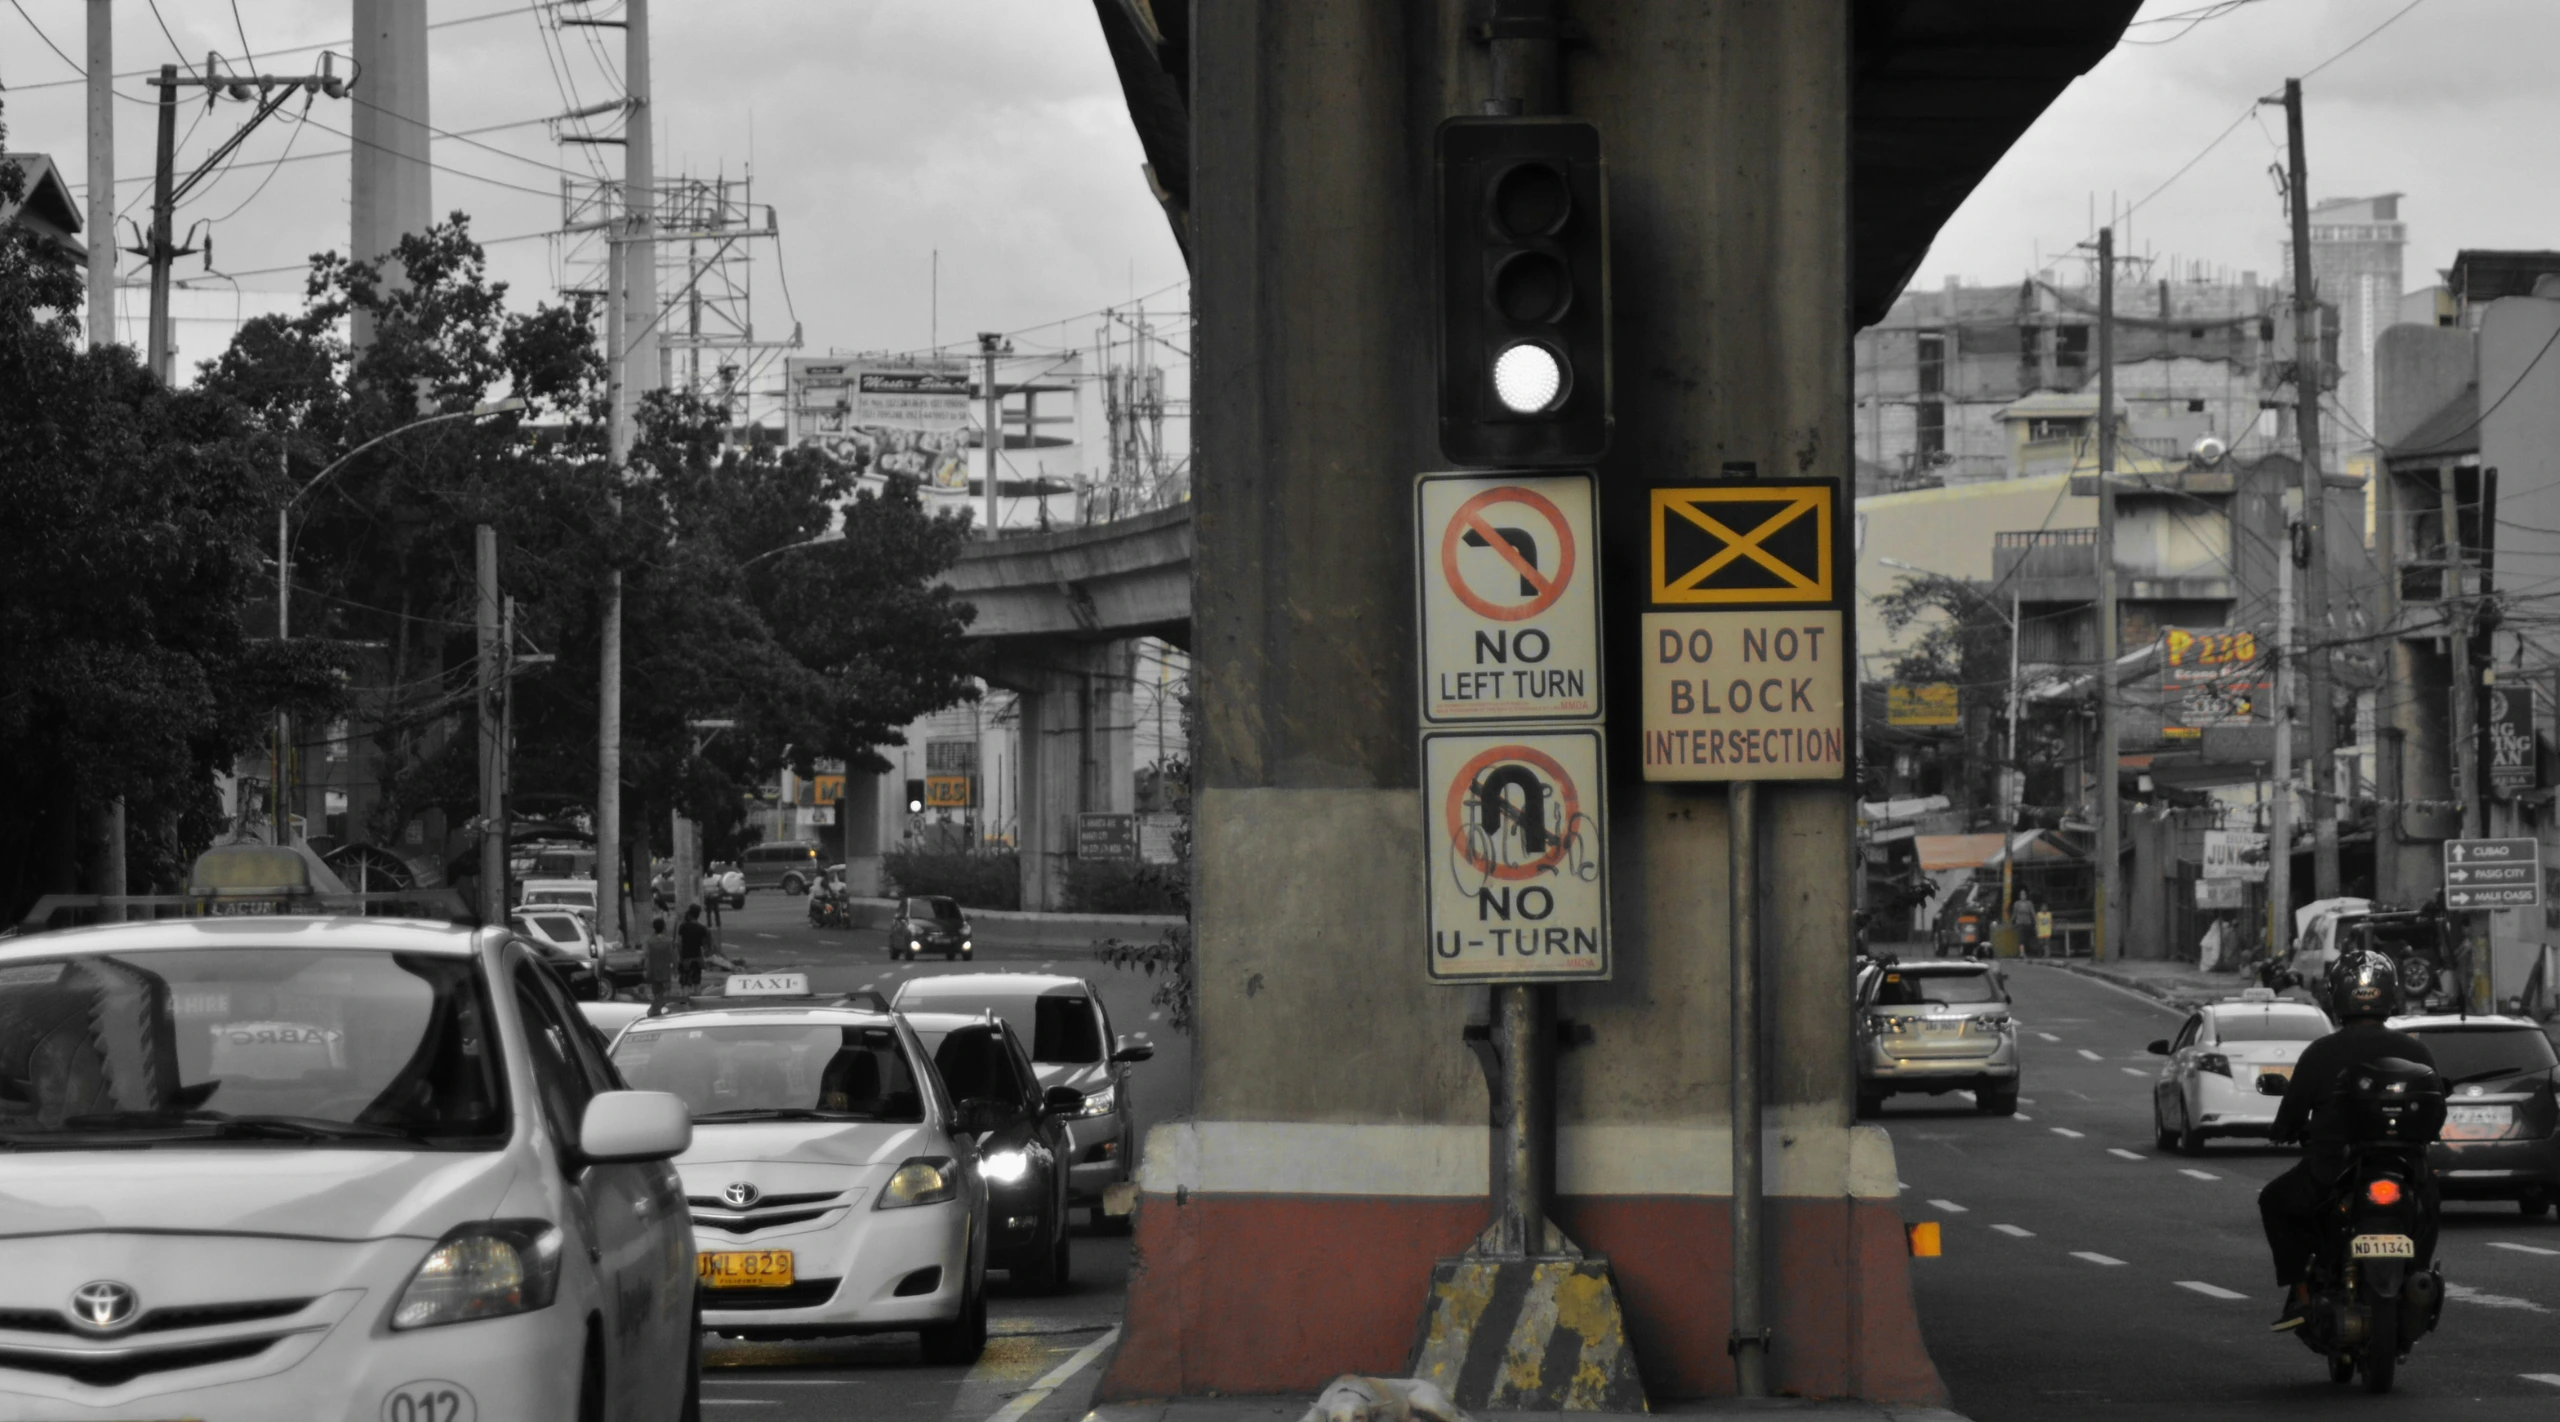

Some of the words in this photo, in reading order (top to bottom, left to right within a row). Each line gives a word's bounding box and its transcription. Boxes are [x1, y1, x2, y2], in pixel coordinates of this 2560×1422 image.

[1475, 628, 1551, 664] NO
[1659, 628, 1713, 664] DO
[1743, 627, 1825, 662] NOT
[2198, 632, 2256, 664] 230
[1441, 671, 1505, 700] LEFT
[1513, 669, 1584, 698] TURN
[1671, 678, 1814, 714] BLOCK
[1560, 702, 1588, 710] MMDA
[1646, 727, 1842, 765] INTERSECTION
[2473, 846, 2510, 856] CUBAO
[2474, 869, 2503, 878] PASIG
[2504, 868, 2526, 877] CITY
[1479, 885, 1554, 921] NO
[2503, 890, 2533, 900] OASIS
[1436, 927, 1598, 958] U-TURN
[738, 979, 791, 990] TAXI
[185, 994, 228, 1013] HIRE
[744, 1255, 789, 1275] 829
[391, 1389, 460, 1422] 012
